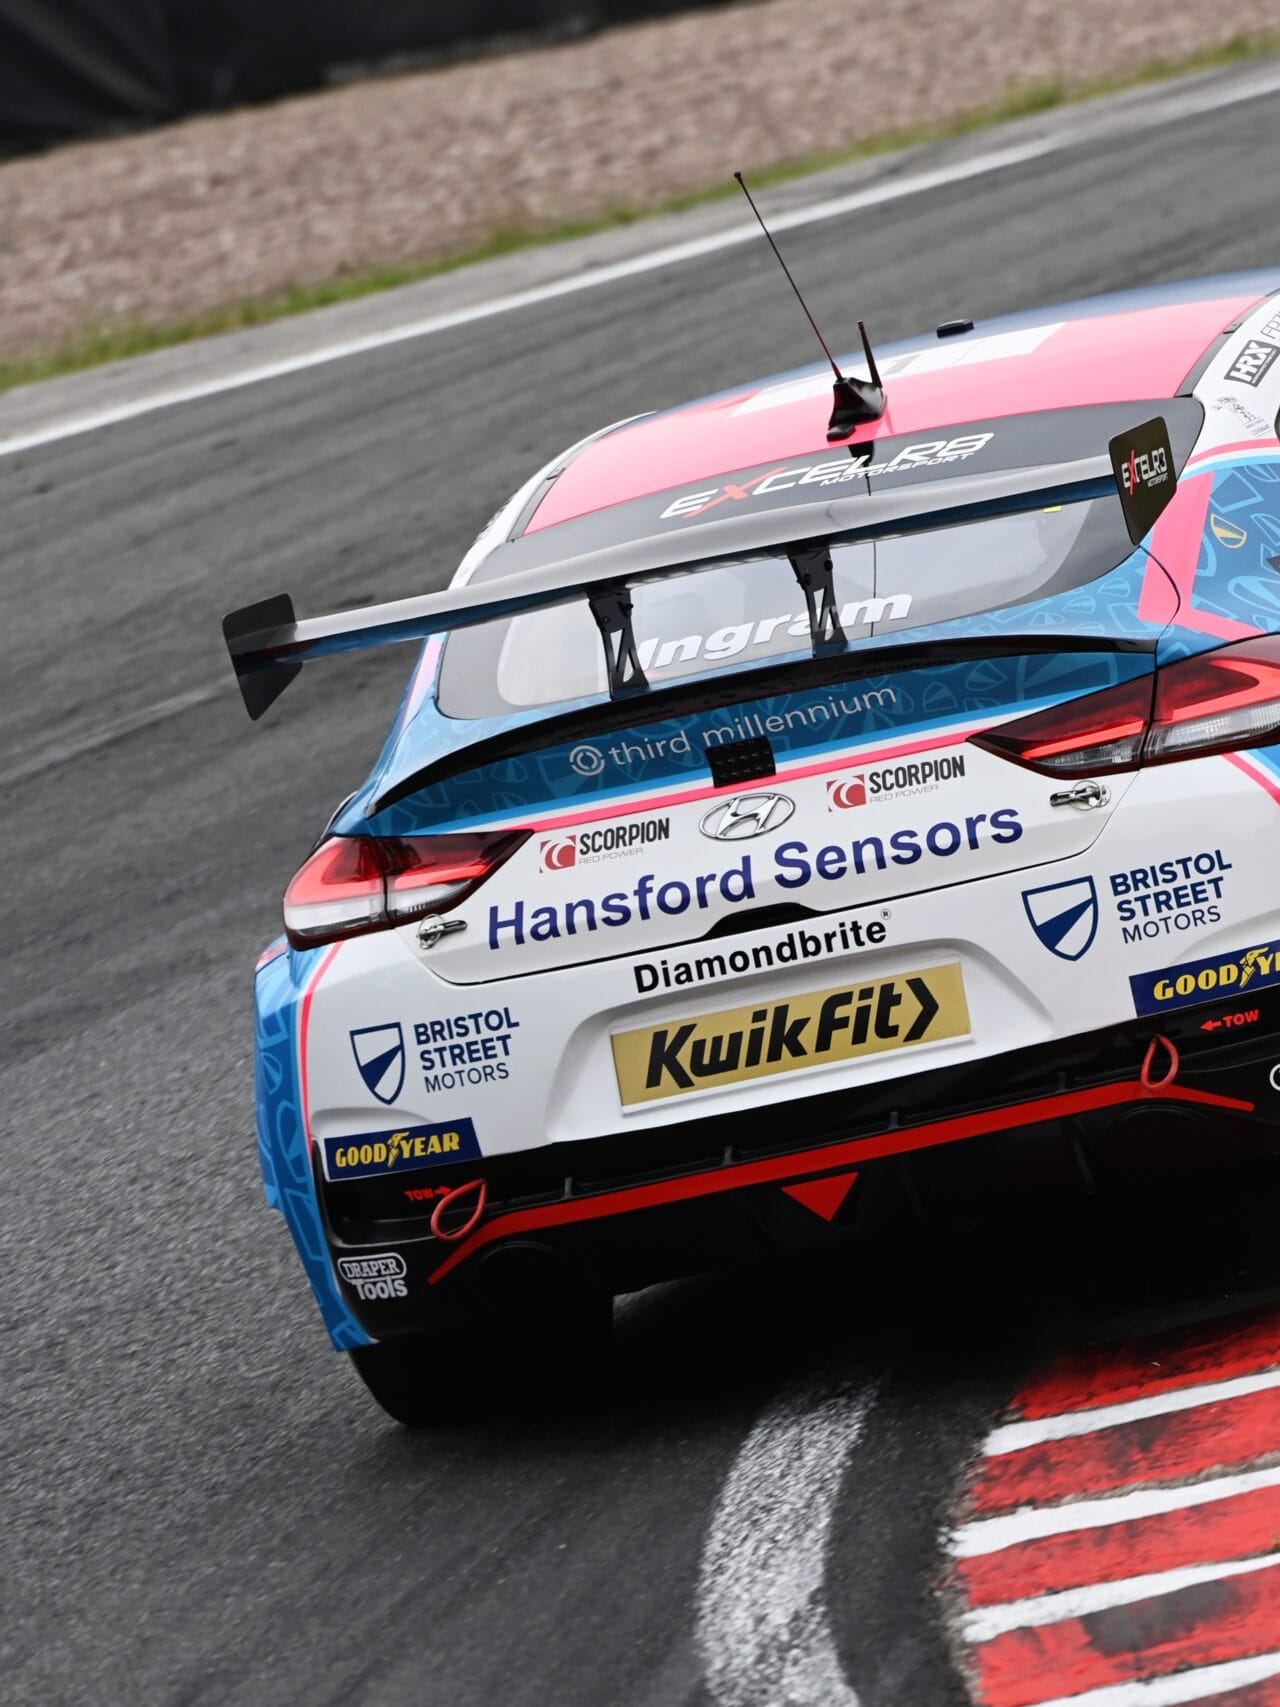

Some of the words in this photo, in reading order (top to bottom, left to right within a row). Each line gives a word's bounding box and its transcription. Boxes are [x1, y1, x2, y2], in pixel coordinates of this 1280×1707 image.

[1230, 340, 1273, 381] HRX
[660, 432, 994, 519] EXCELR8
[820, 453, 975, 486] MOTORSPORT
[608, 729, 691, 768] third
[702, 685, 898, 746] millennium
[868, 755, 966, 794] SCORPION
[870, 790, 899, 804] RED
[901, 783, 939, 799] POWER
[579, 817, 670, 856] SCORPION
[579, 855, 601, 865] RED
[602, 847, 644, 861] POWER
[1110, 849, 1233, 897] BRISTOL
[488, 855, 756, 950] Hansford
[774, 808, 1024, 890] Sensors
[1116, 876, 1225, 922] STREET
[1122, 905, 1221, 945] MOTORS
[413, 1007, 521, 1045] BRISTOL
[1223, 1009, 1259, 1028] TOW
[419, 1034, 512, 1071] STREET
[424, 1061, 510, 1094] MOTORS
[404, 1187, 434, 1201] TOW
[342, 1257, 400, 1279] DRAPER
